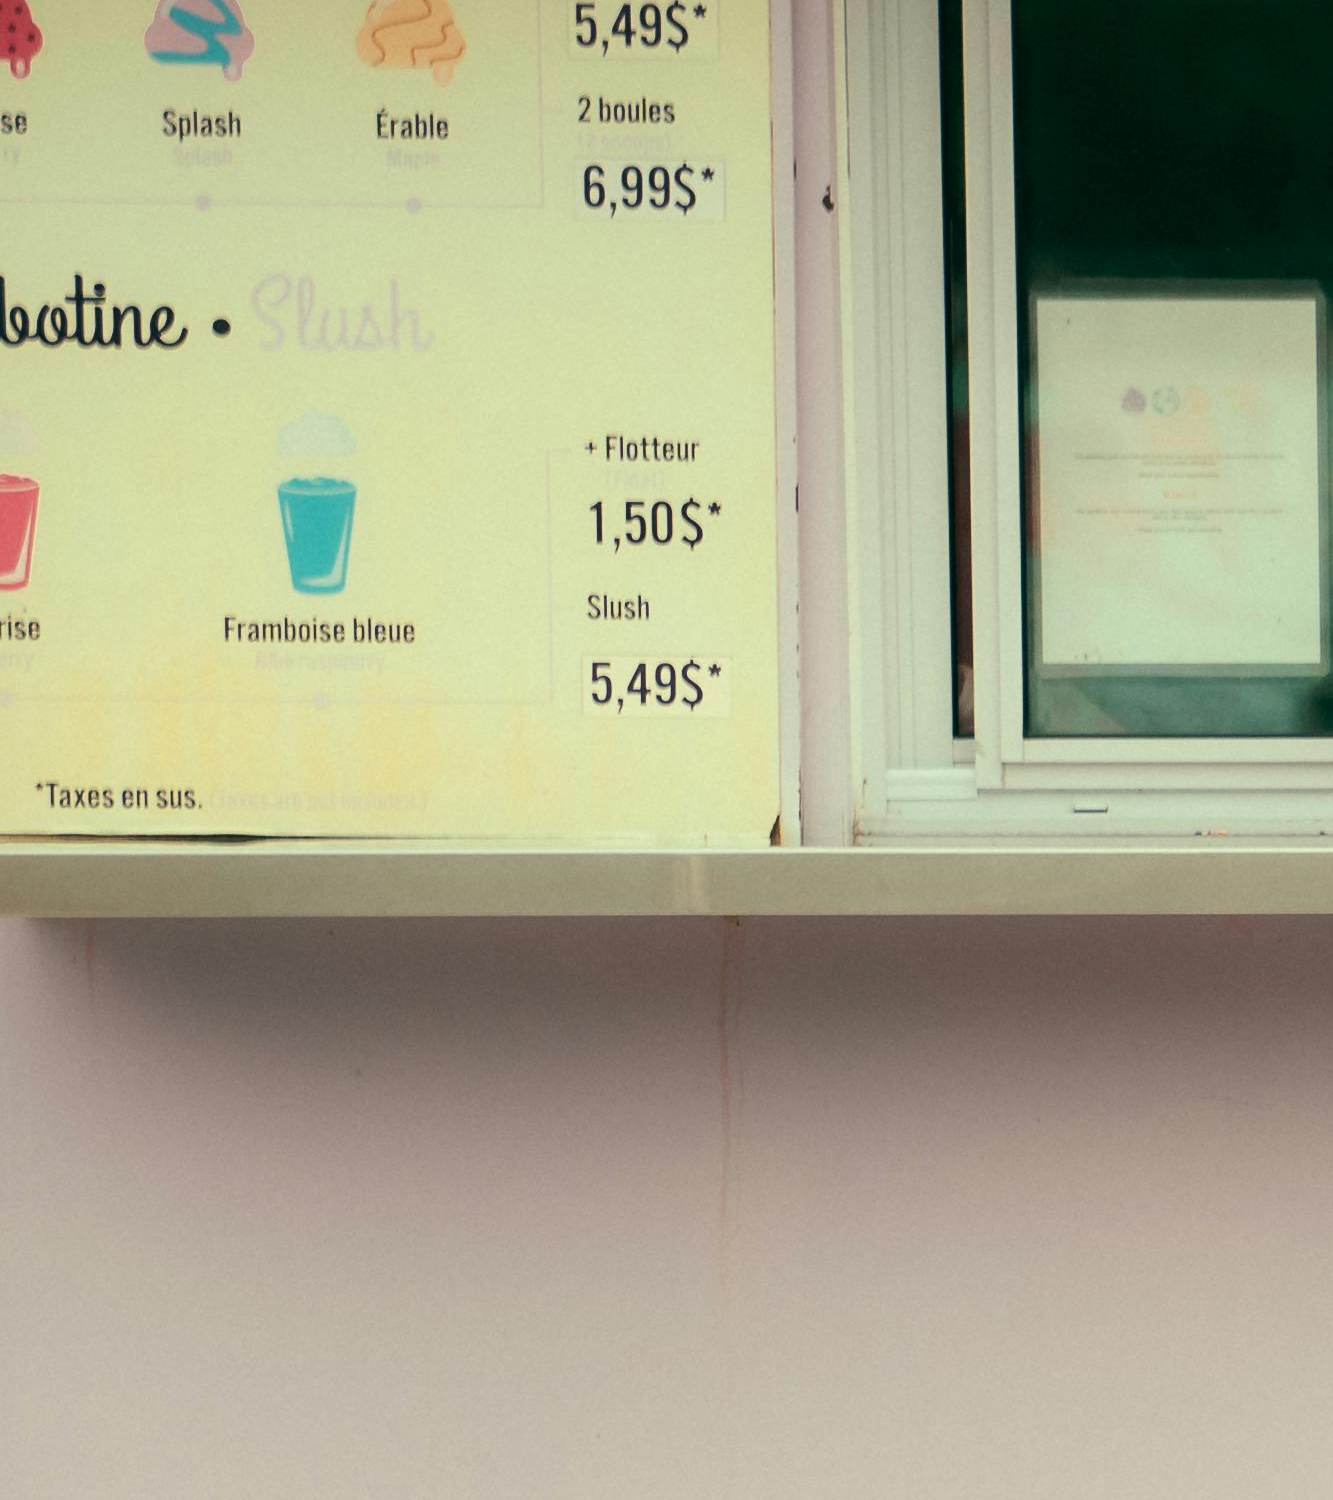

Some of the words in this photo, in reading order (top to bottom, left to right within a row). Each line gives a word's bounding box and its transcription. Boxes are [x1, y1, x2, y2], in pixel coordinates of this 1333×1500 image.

[376, 107, 449, 139] Érable
[578, 96, 591, 123] 2
[598, 96, 676, 124] boules
[162, 110, 241, 143] Splash
[251, 274, 438, 353] Slush
[605, 435, 700, 462] Flotteur
[587, 594, 650, 620] Slush
[224, 616, 345, 643] Framboise
[353, 617, 415, 643] bleue
[121, 789, 149, 809] en
[156, 789, 202, 809] sus.
